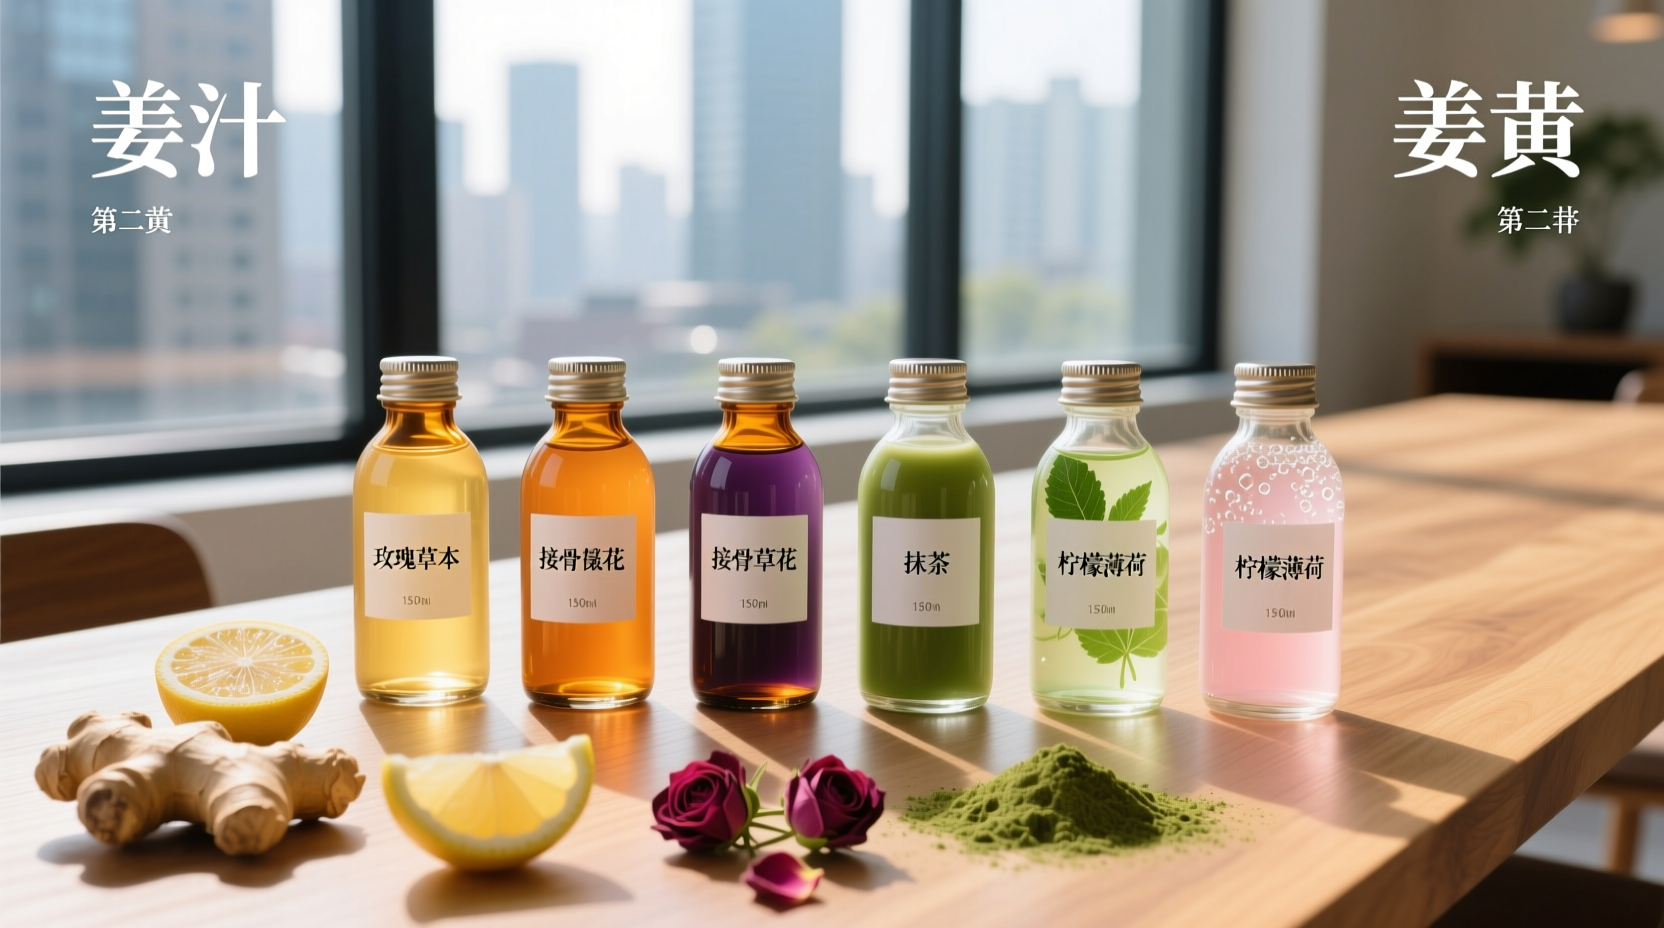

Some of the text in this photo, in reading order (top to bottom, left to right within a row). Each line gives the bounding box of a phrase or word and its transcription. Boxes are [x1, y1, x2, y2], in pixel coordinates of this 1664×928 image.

[373, 546, 460, 570] 玫瑰草本
[711, 546, 798, 572] 接骨草花
[904, 550, 950, 576] 抹茶
[1058, 550, 1147, 577] 柠檬薄荷
[1234, 555, 1324, 580] 柠檬薄荷
[741, 598, 768, 609] 150ml
